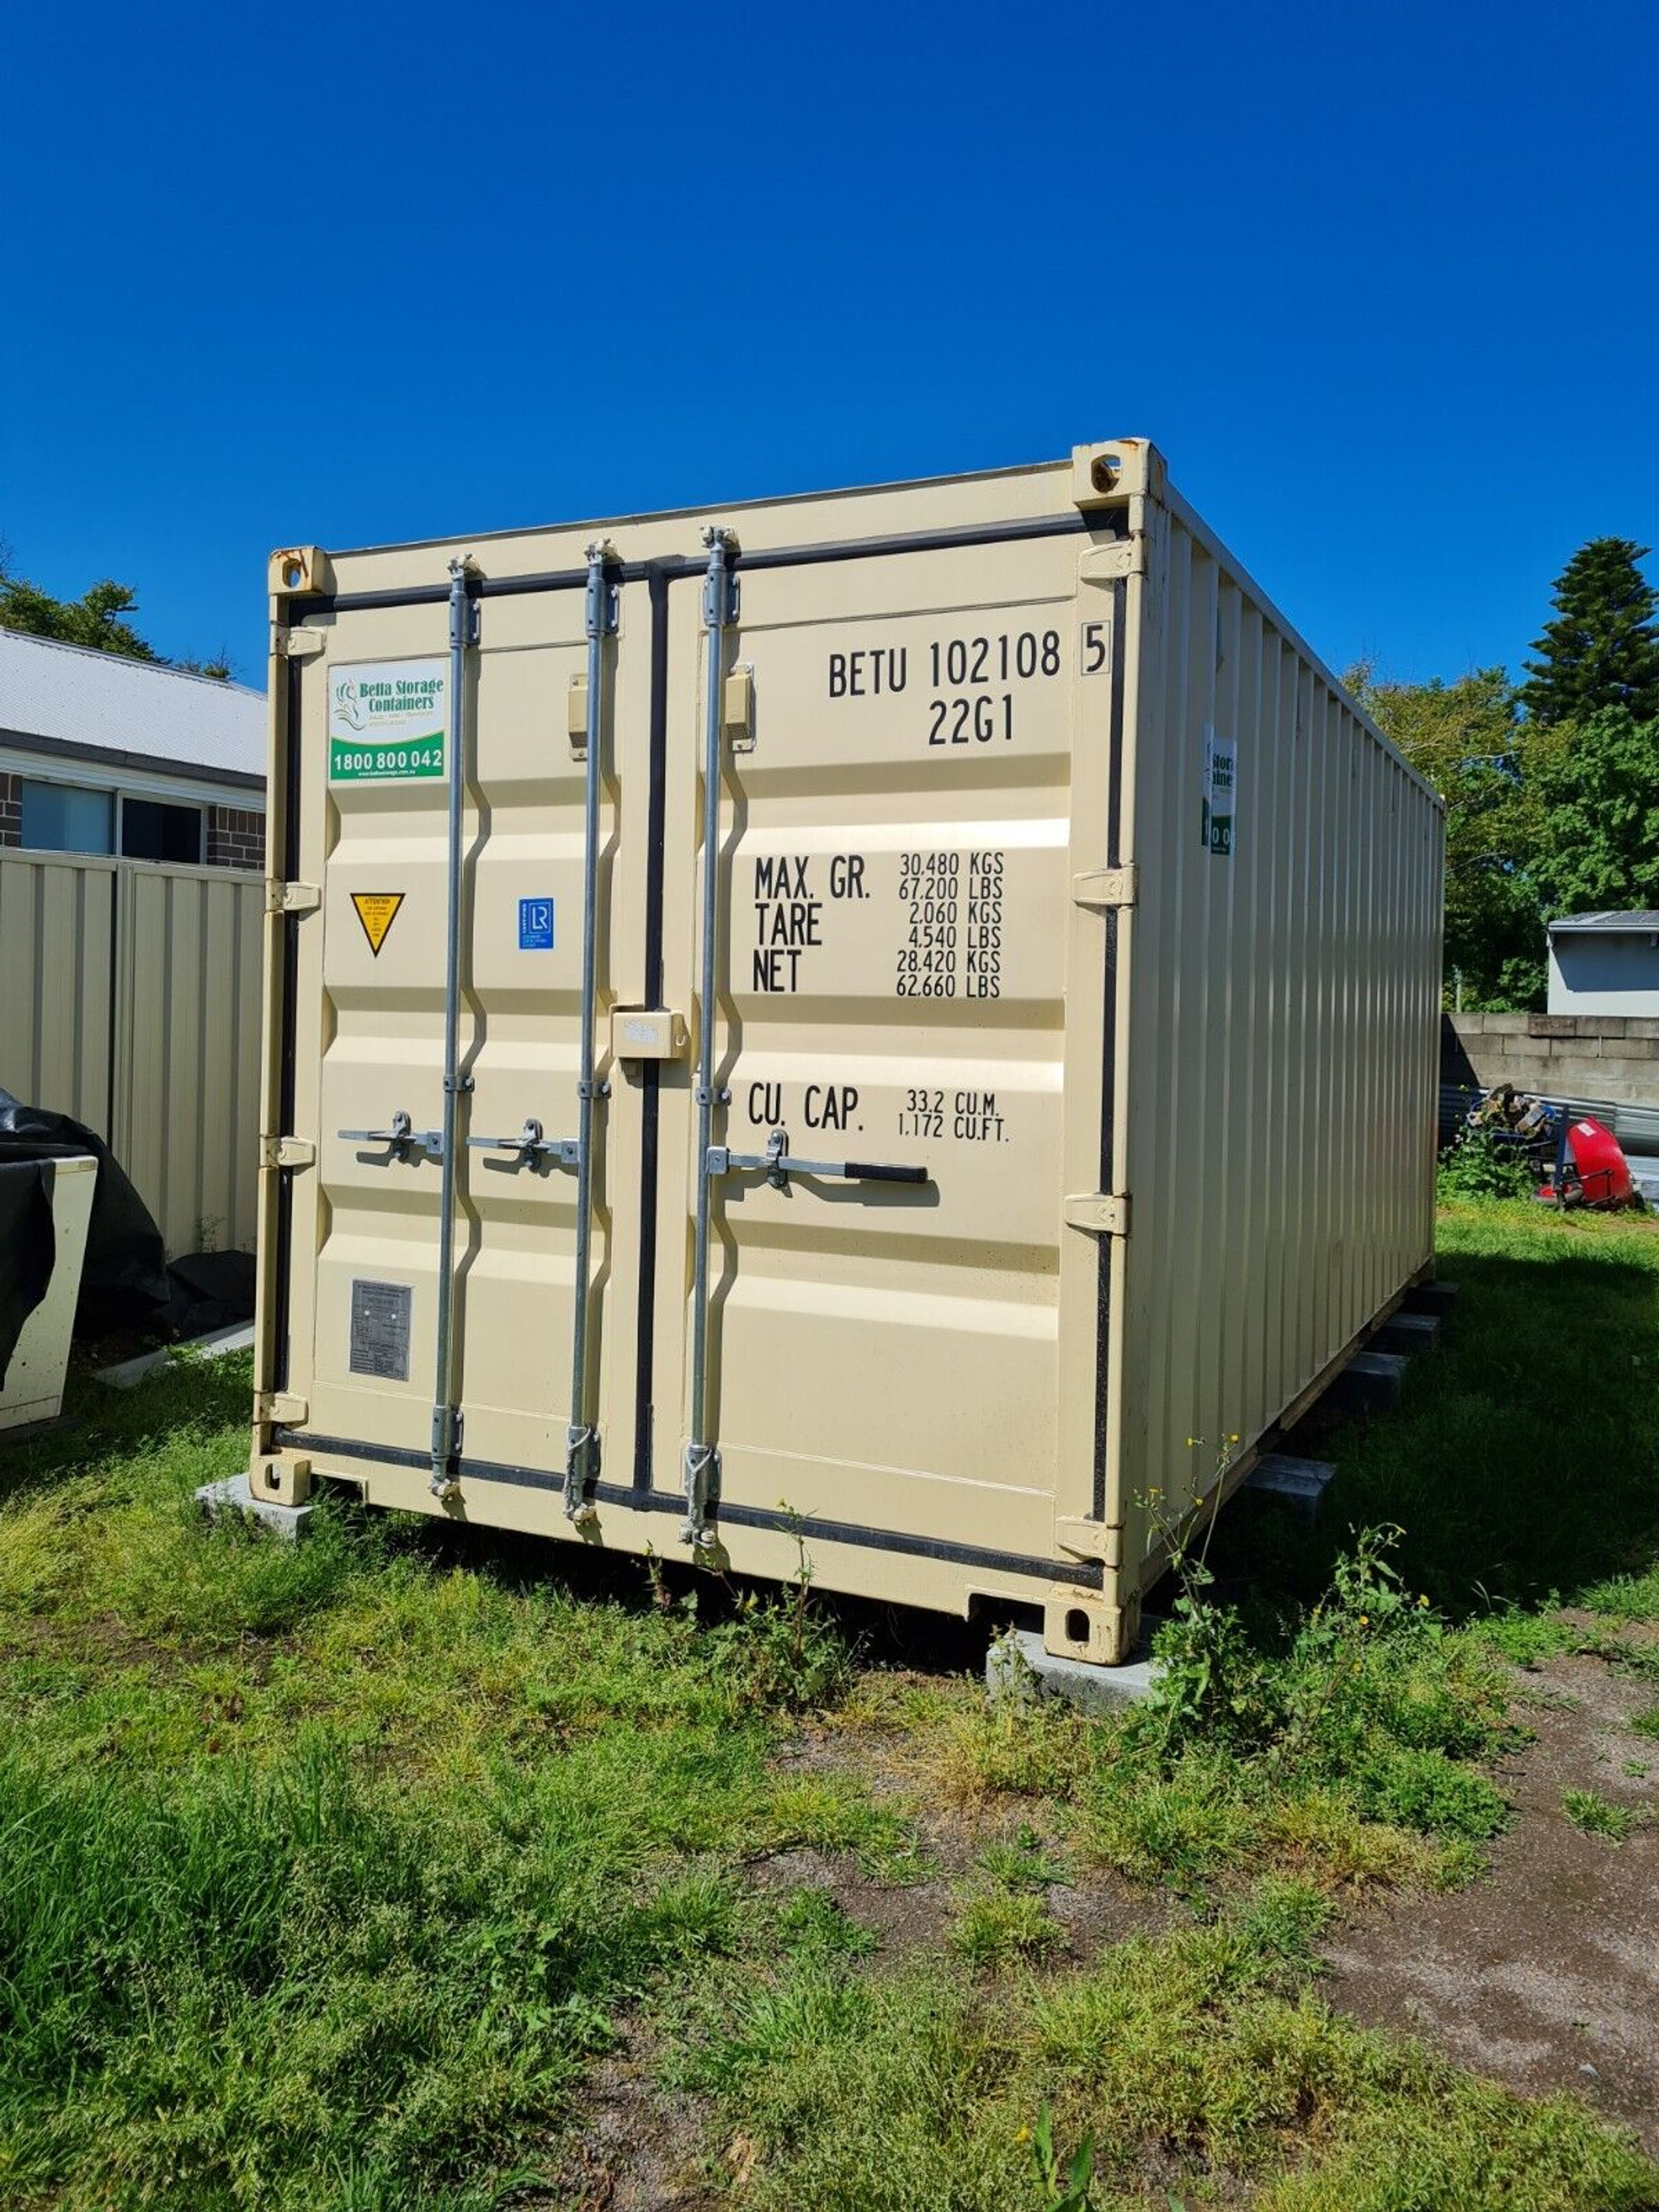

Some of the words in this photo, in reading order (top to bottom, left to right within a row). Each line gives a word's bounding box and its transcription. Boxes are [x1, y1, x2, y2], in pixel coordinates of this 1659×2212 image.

[829, 647, 906, 698] BETU
[930, 630, 1060, 687] 102108
[1086, 624, 1106, 672] 5
[396, 679, 443, 695] Storage
[369, 695, 434, 713] Containers
[928, 694, 1012, 745] 22G1
[334, 753, 372, 771] 1800
[376, 751, 407, 769] 800
[411, 749, 442, 767] 042
[755, 855, 814, 899] MAX.
[830, 855, 870, 899] GR.
[970, 851, 1003, 875] KGS
[969, 876, 1003, 900] LBS
[532, 907, 548, 929] LR
[755, 902, 823, 946] TARE
[968, 901, 1002, 924] KGS
[968, 925, 1001, 949] LBS
[753, 949, 802, 992] NET
[967, 950, 1001, 974] KGS
[966, 974, 1000, 999] LBS
[749, 1082, 786, 1126] CU.
[804, 1085, 863, 1131] CAP.
[906, 1089, 944, 1114] 33.2
